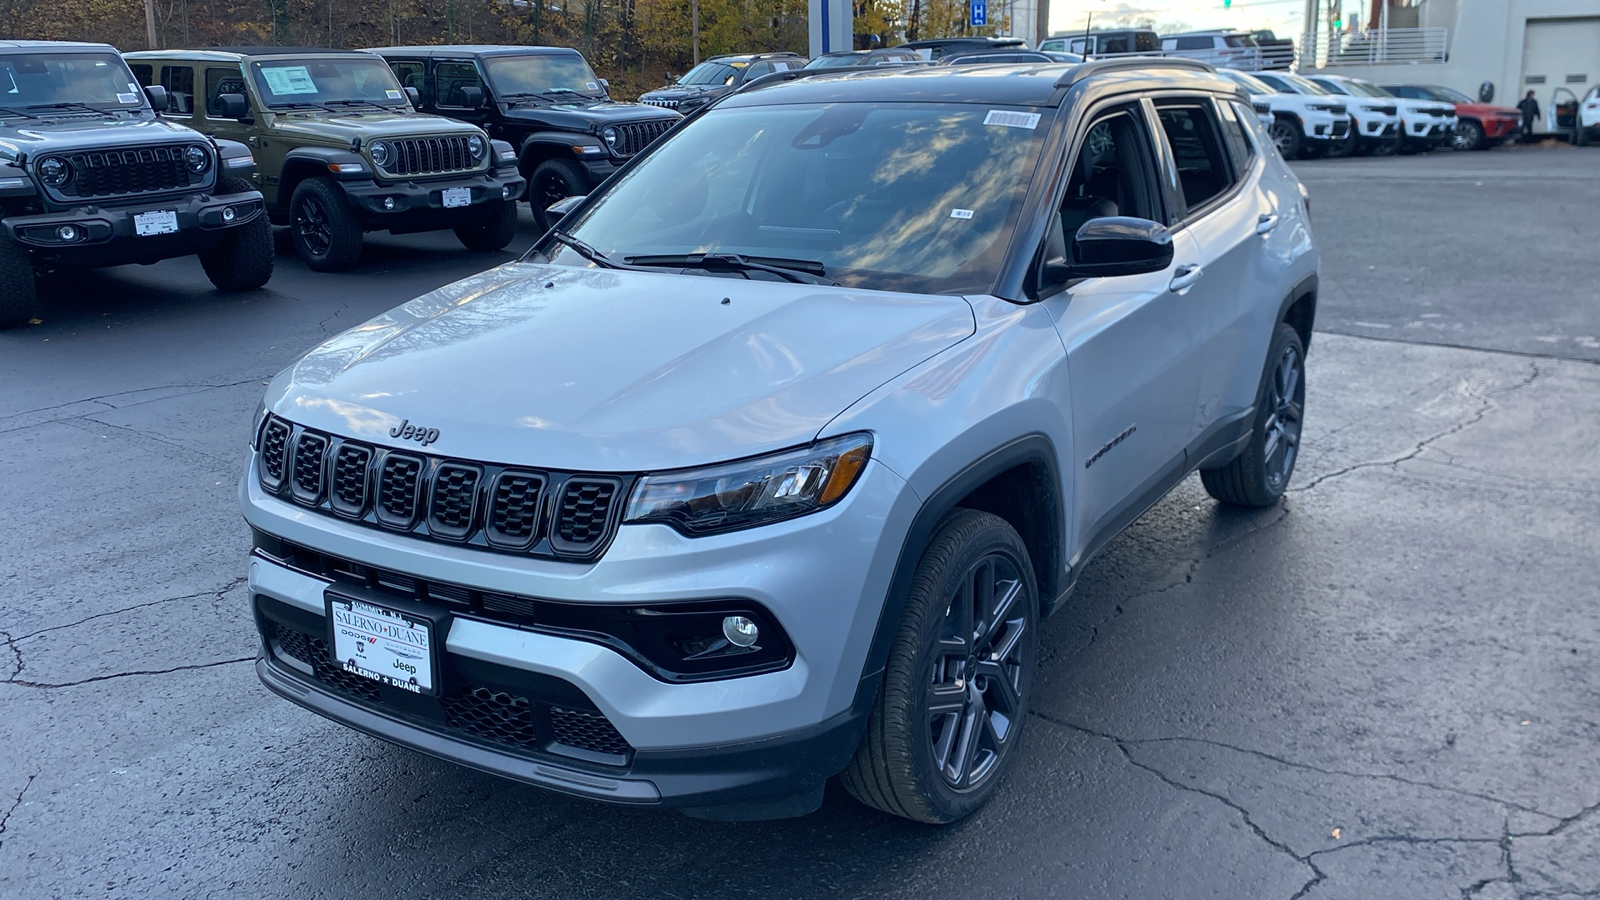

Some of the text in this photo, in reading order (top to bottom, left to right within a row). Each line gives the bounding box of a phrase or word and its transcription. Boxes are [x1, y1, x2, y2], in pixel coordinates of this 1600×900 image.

[974, 5, 983, 18] H
[389, 419, 440, 447] Jeep
[335, 610, 428, 647] SALERNO DUANE
[343, 663, 421, 694] SALERNO DUANE
[392, 658, 417, 675] Jeep
